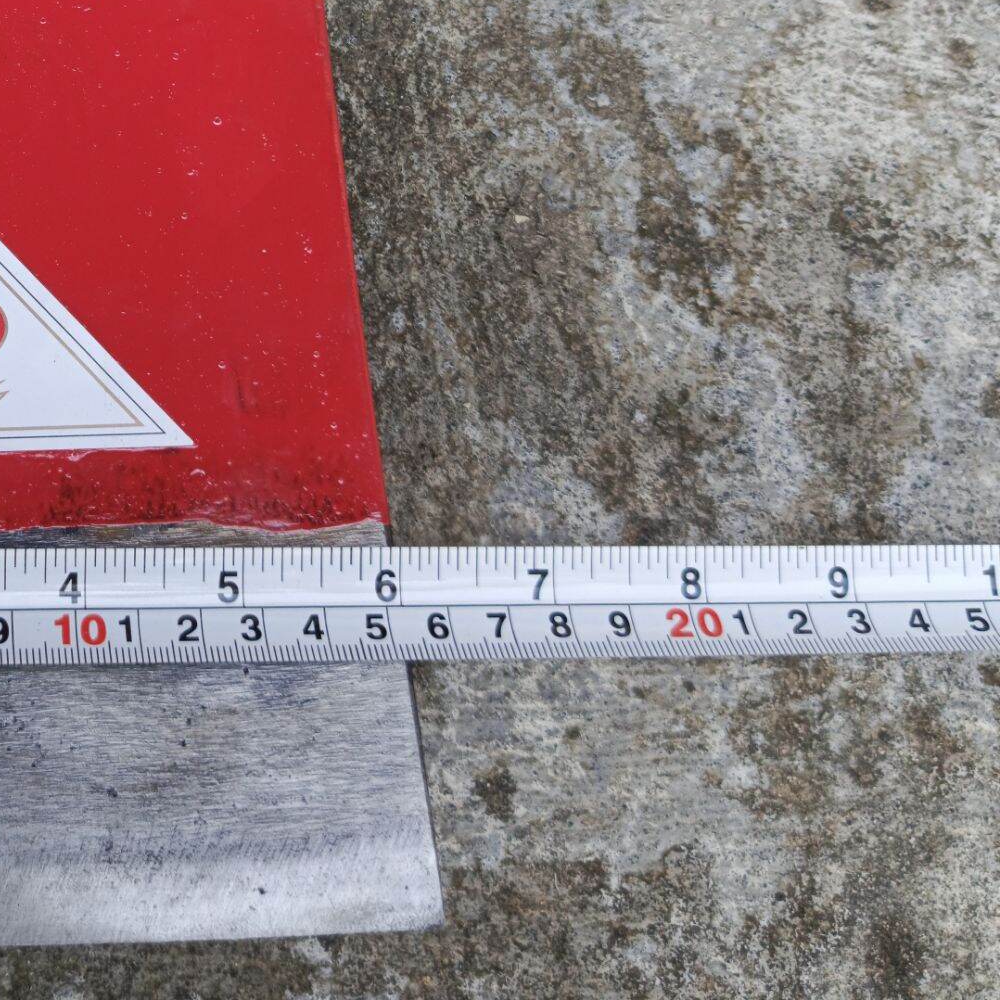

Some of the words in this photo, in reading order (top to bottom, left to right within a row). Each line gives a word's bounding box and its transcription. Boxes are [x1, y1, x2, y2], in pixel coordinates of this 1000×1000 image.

[59, 572, 81, 604] 4
[218, 570, 239, 602] 5
[375, 569, 397, 601] 6
[527, 568, 548, 600] 7
[681, 567, 702, 599] 8
[828, 566, 849, 598] 9
[119, 616, 133, 642] 1
[178, 615, 199, 642] 2
[241, 614, 263, 642] 3
[302, 614, 325, 640] 4
[365, 614, 388, 640] 5
[427, 613, 450, 639] 6
[486, 612, 507, 638] 7
[549, 611, 572, 637] 8
[608, 611, 632, 637] 9
[733, 610, 750, 635] 1
[789, 609, 812, 635] 2
[847, 609, 871, 634] 3
[909, 608, 930, 632] 4
[965, 608, 990, 632] 5
